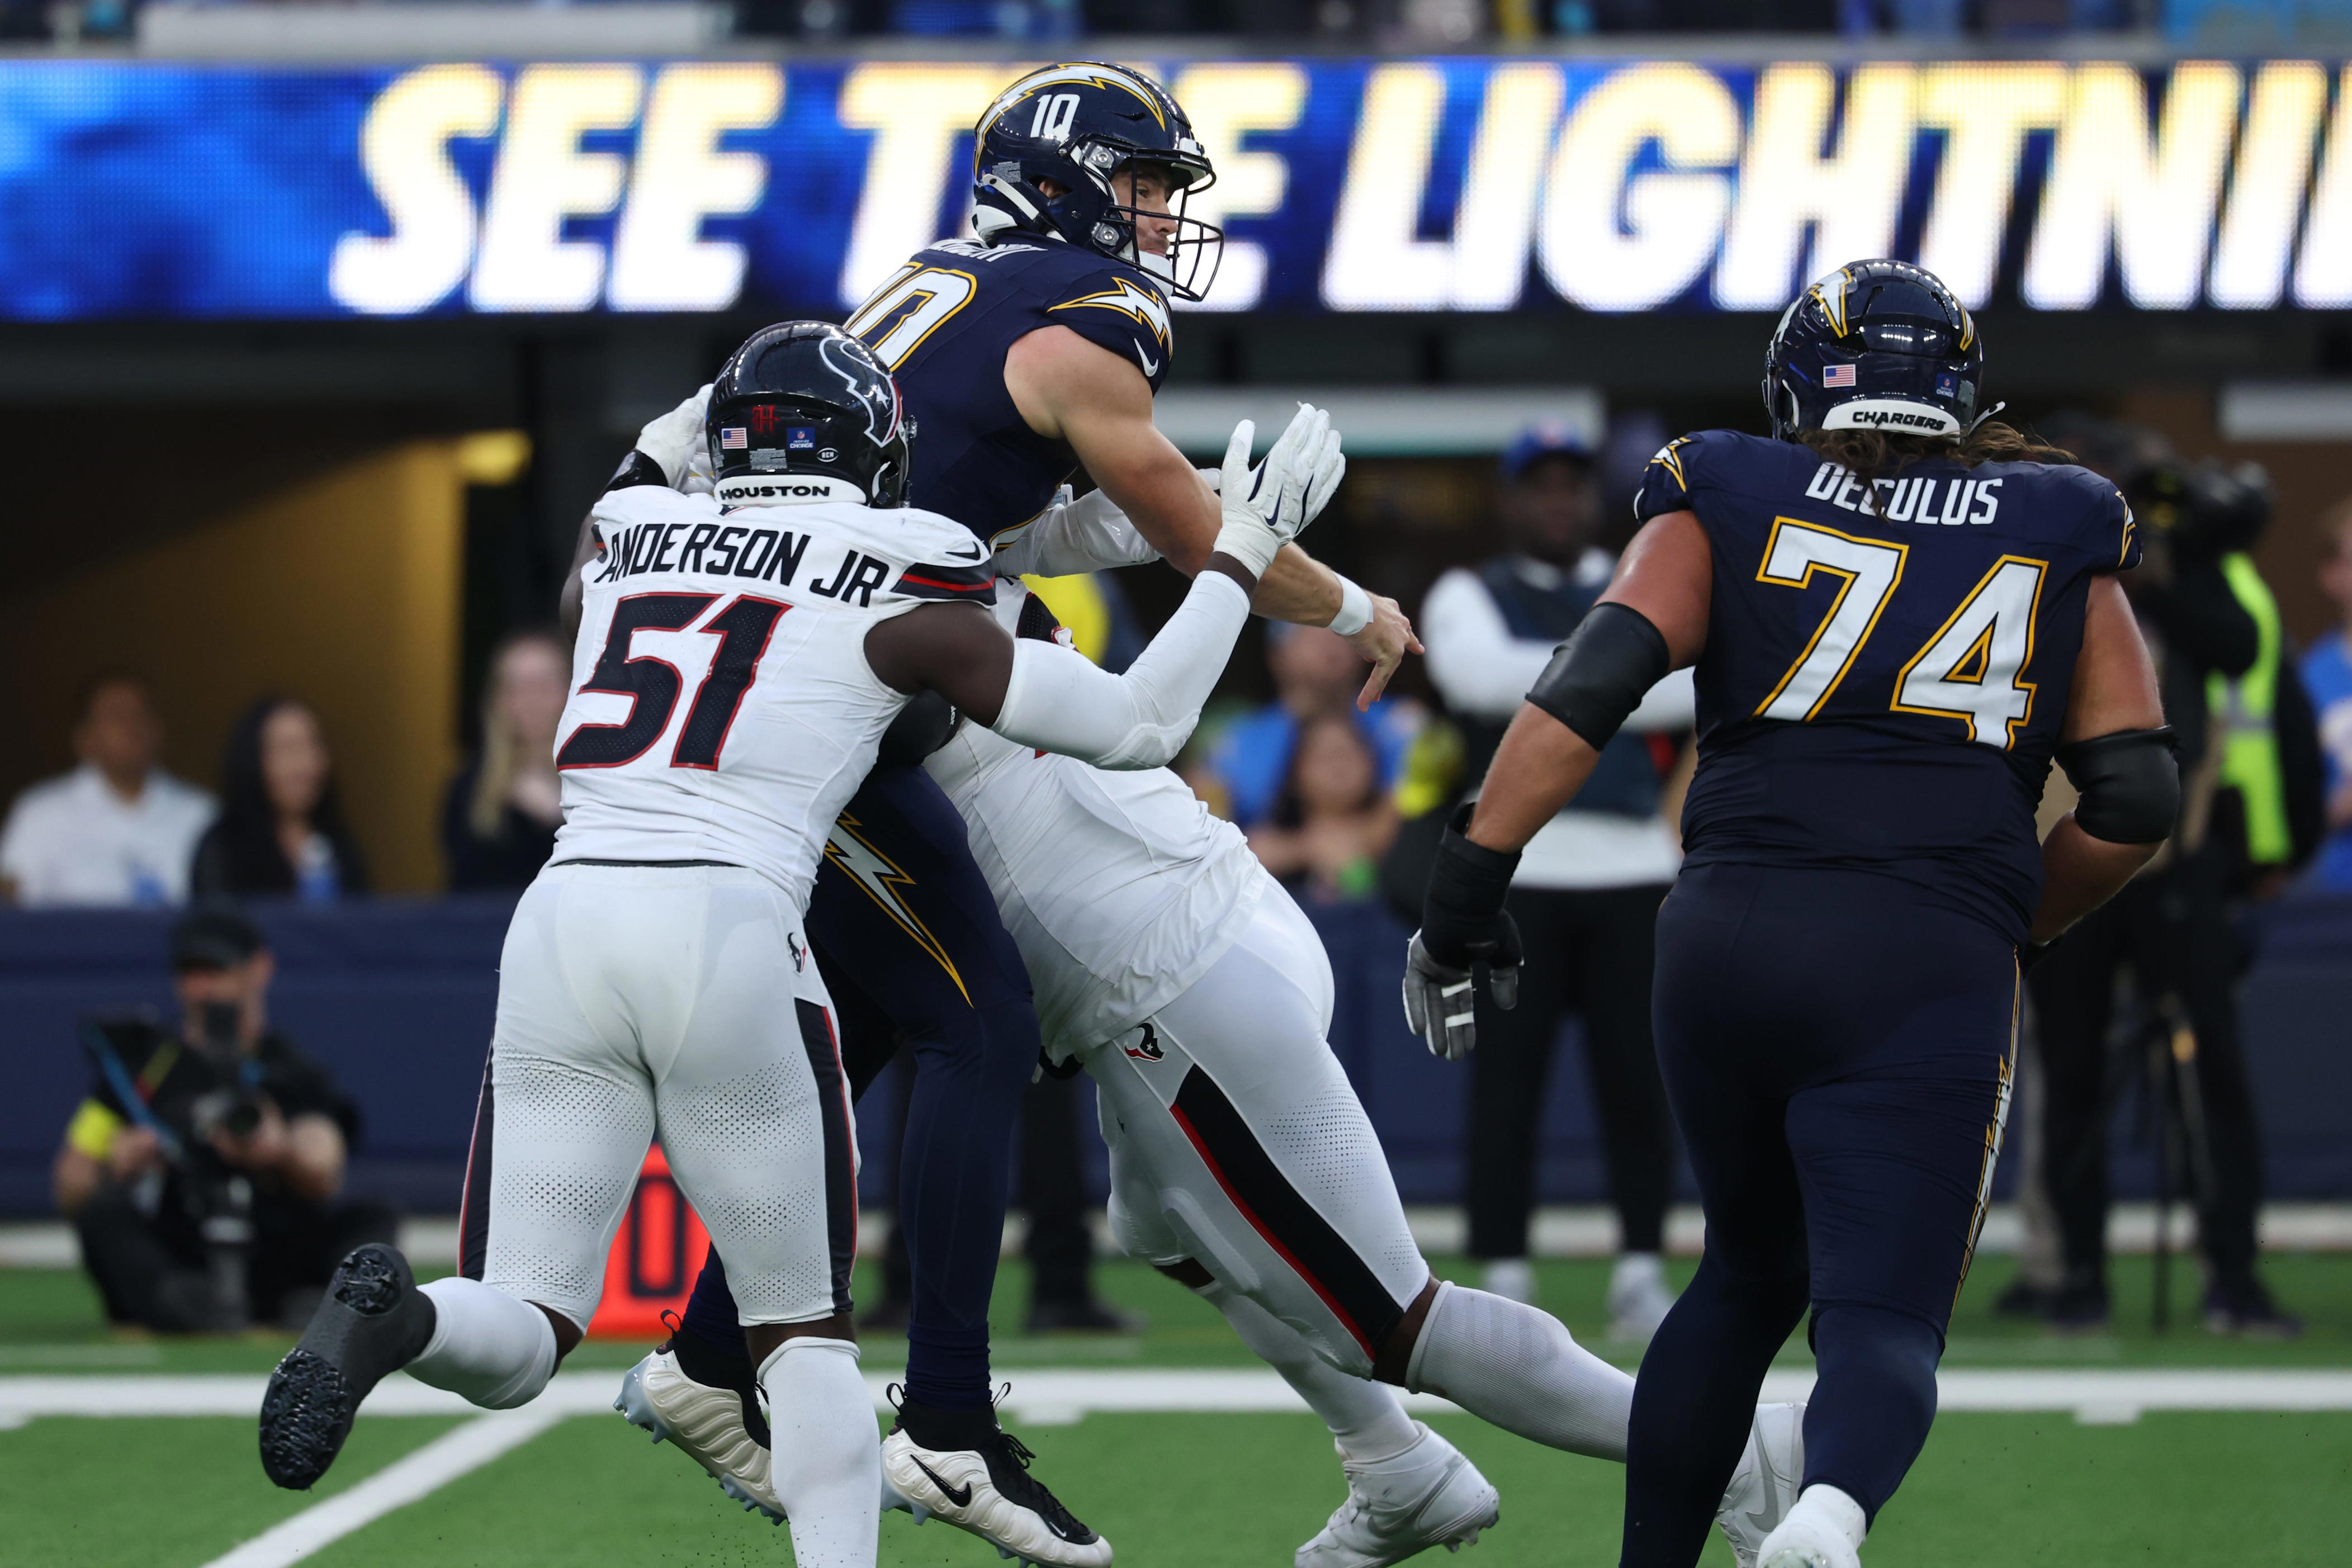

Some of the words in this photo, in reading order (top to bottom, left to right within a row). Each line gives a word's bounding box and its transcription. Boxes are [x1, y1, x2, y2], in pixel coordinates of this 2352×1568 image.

[1030, 94, 1081, 144] 10
[330, 61, 785, 314] SEE
[837, 61, 1311, 313] TE
[1852, 411, 1946, 431] CHARGERS
[720, 486, 830, 500] HOUSTON
[1805, 461, 2003, 525] DECULUS
[594, 523, 811, 586] ANDERSON
[810, 549, 890, 607] JR
[1752, 515, 2049, 752] 74
[556, 591, 793, 771] 51
